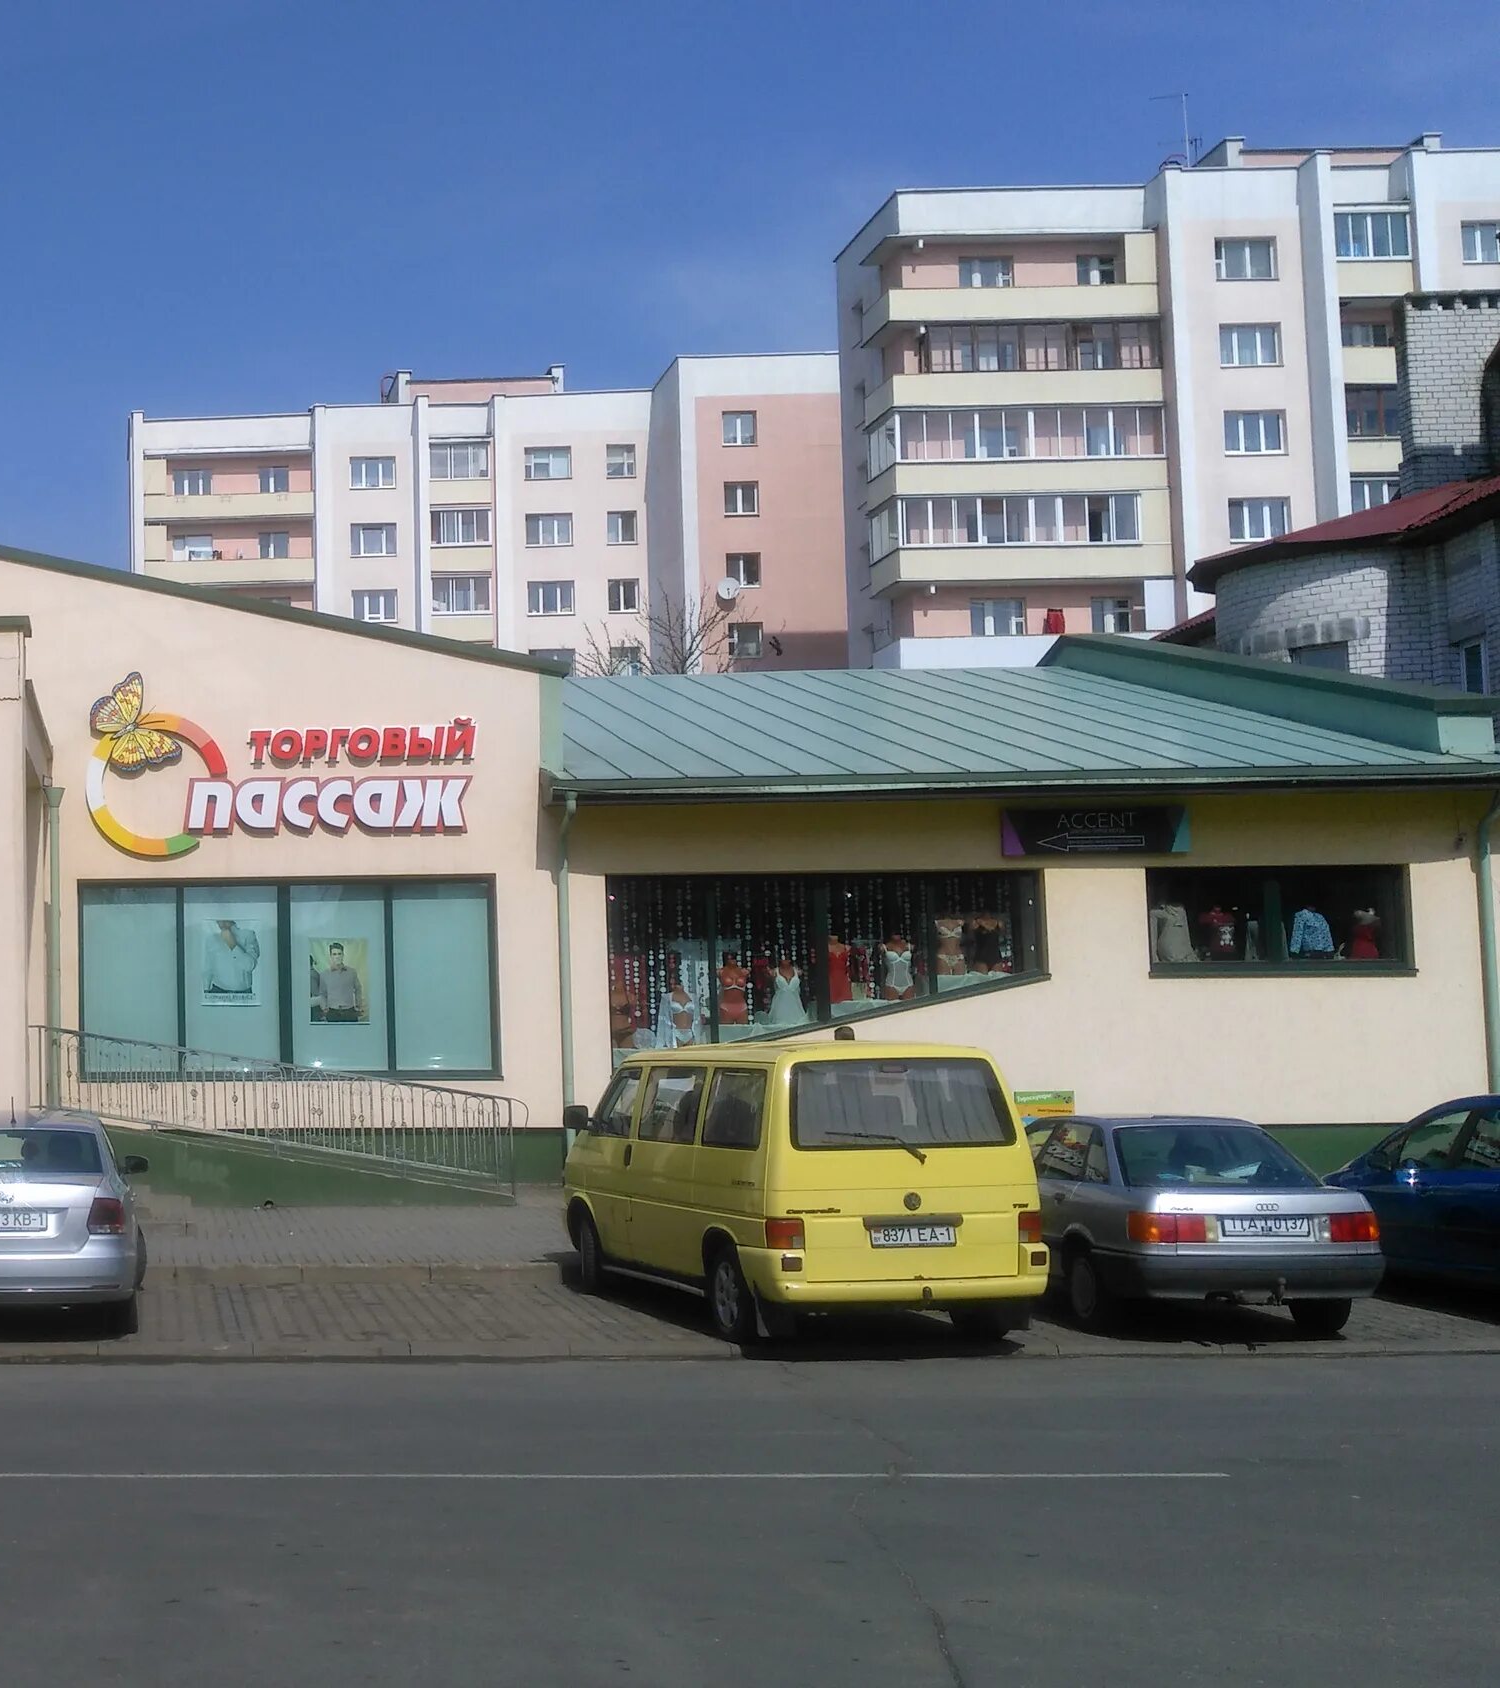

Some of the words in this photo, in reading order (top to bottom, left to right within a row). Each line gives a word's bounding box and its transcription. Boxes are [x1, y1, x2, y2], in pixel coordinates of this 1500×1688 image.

[248, 716, 477, 762] ТОРГОВЫЙ
[1057, 811, 1138, 829] ACCENT
[13, 1213, 43, 1226] KB-1
[882, 1227, 912, 1242] 8371
[917, 1227, 951, 1242] EA-1
